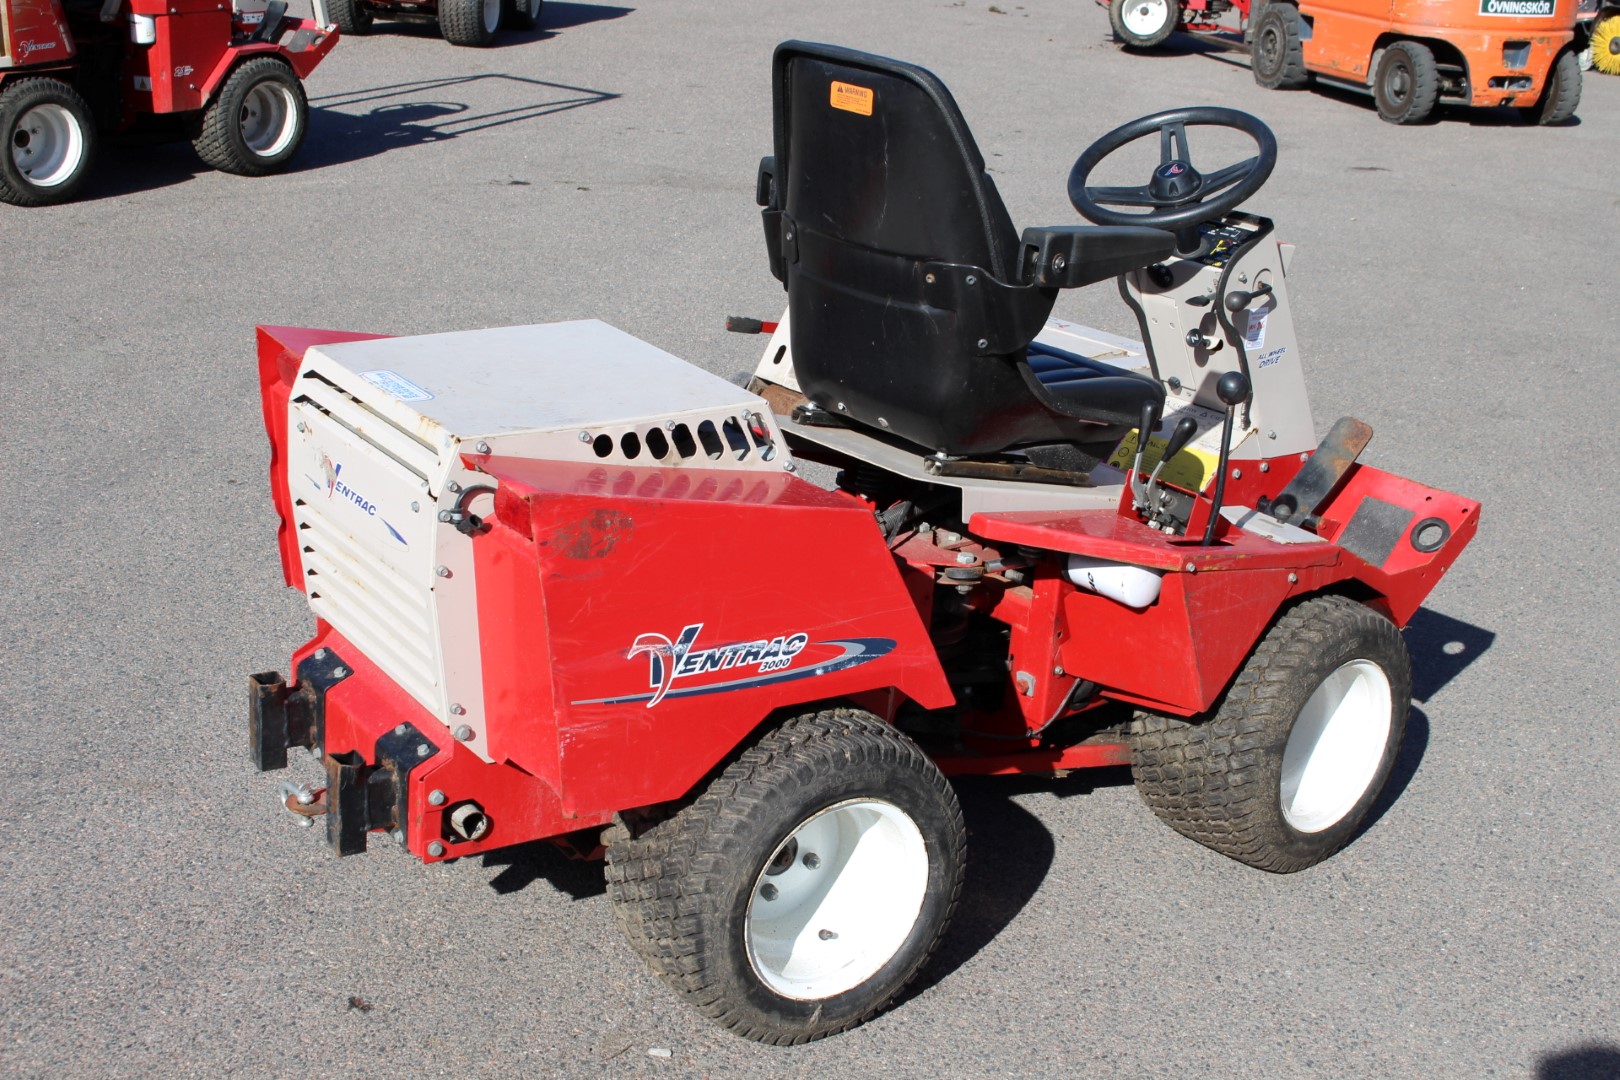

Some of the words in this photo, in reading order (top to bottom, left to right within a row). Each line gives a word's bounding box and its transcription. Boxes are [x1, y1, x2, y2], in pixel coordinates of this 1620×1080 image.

[1487, 0, 1550, 13] ÖVNINGSKÖR
[627, 623, 808, 708] VENTRAC
[758, 658, 792, 673] 3000
